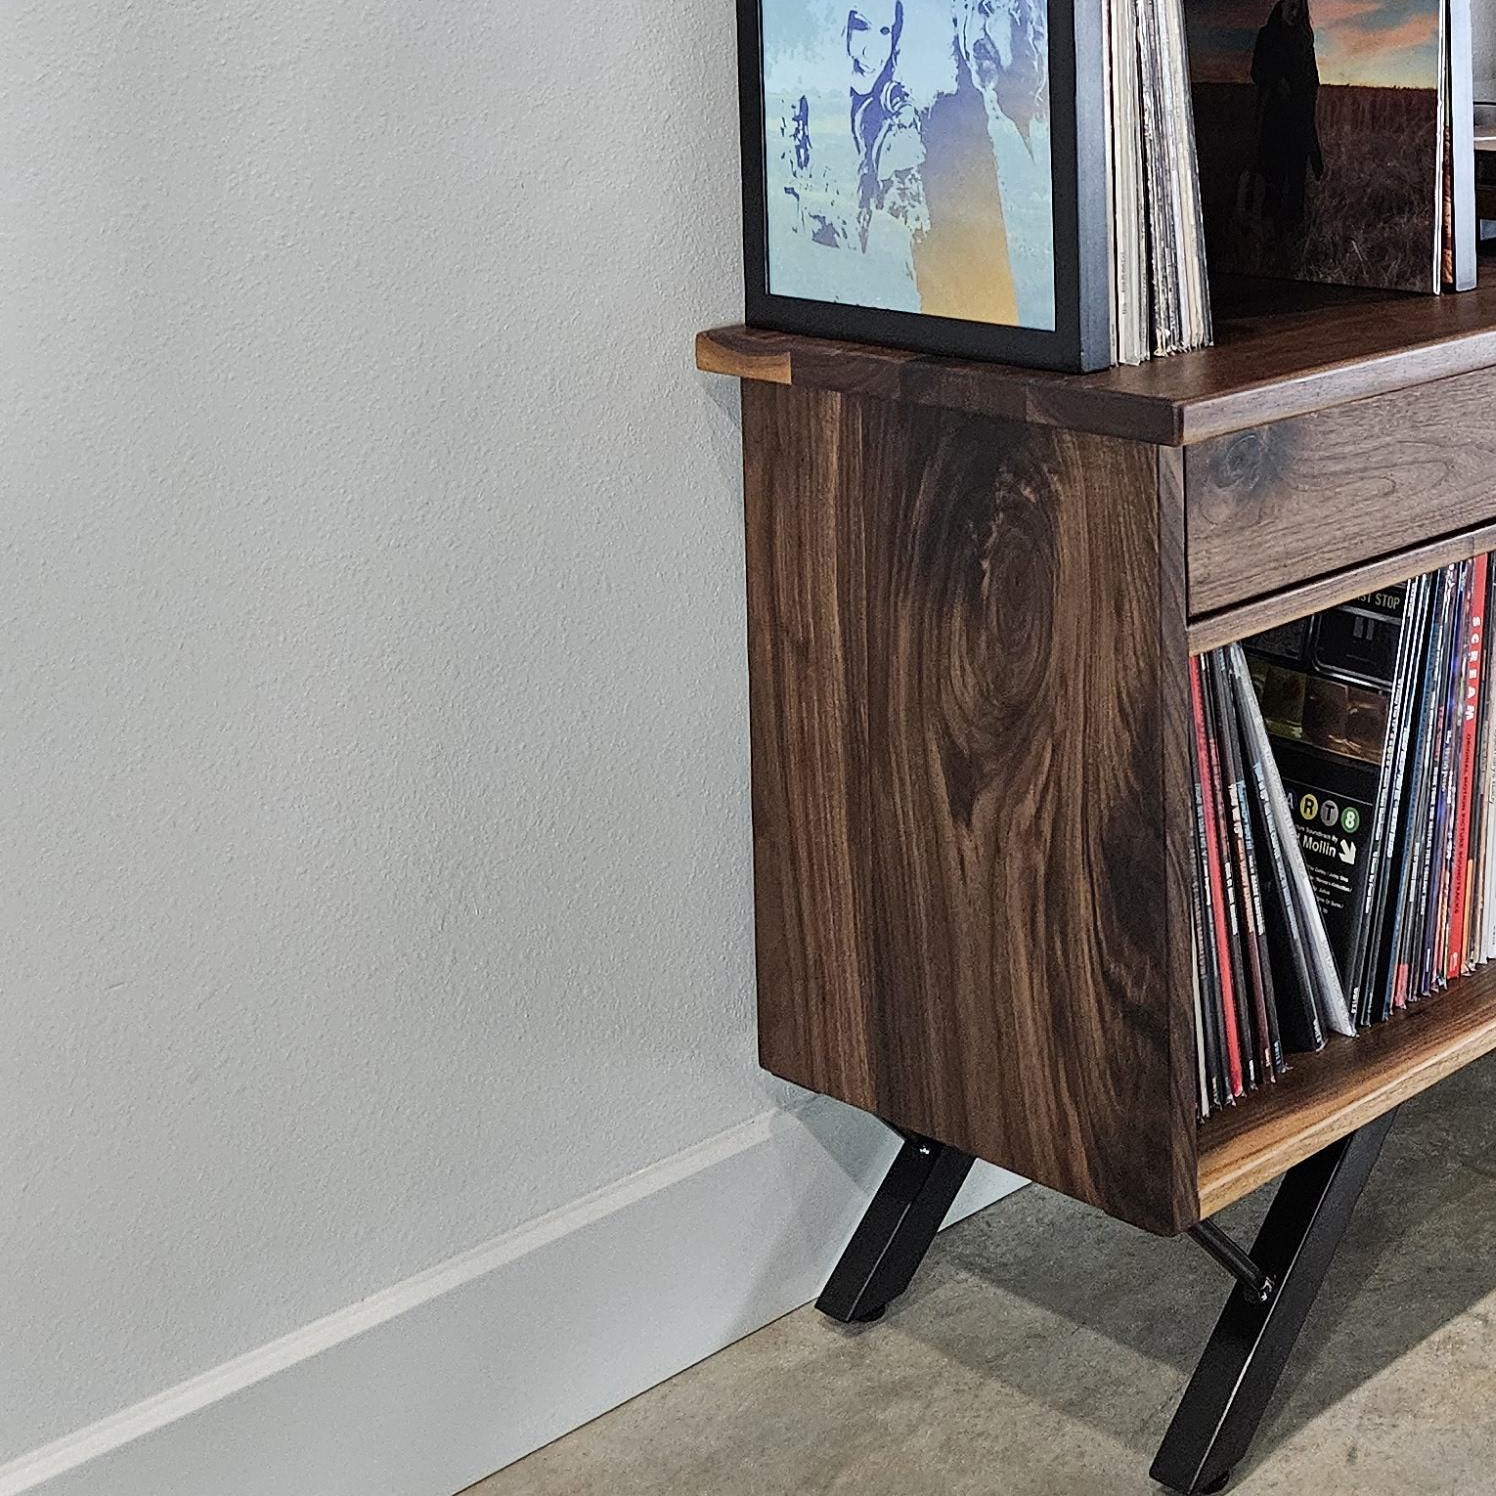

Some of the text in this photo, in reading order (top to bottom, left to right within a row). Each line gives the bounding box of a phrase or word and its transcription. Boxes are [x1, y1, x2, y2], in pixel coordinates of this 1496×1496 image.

[1375, 592, 1400, 609] STOP
[1465, 616, 1480, 720] SCREAM
[1303, 834, 1337, 857] Mollin
